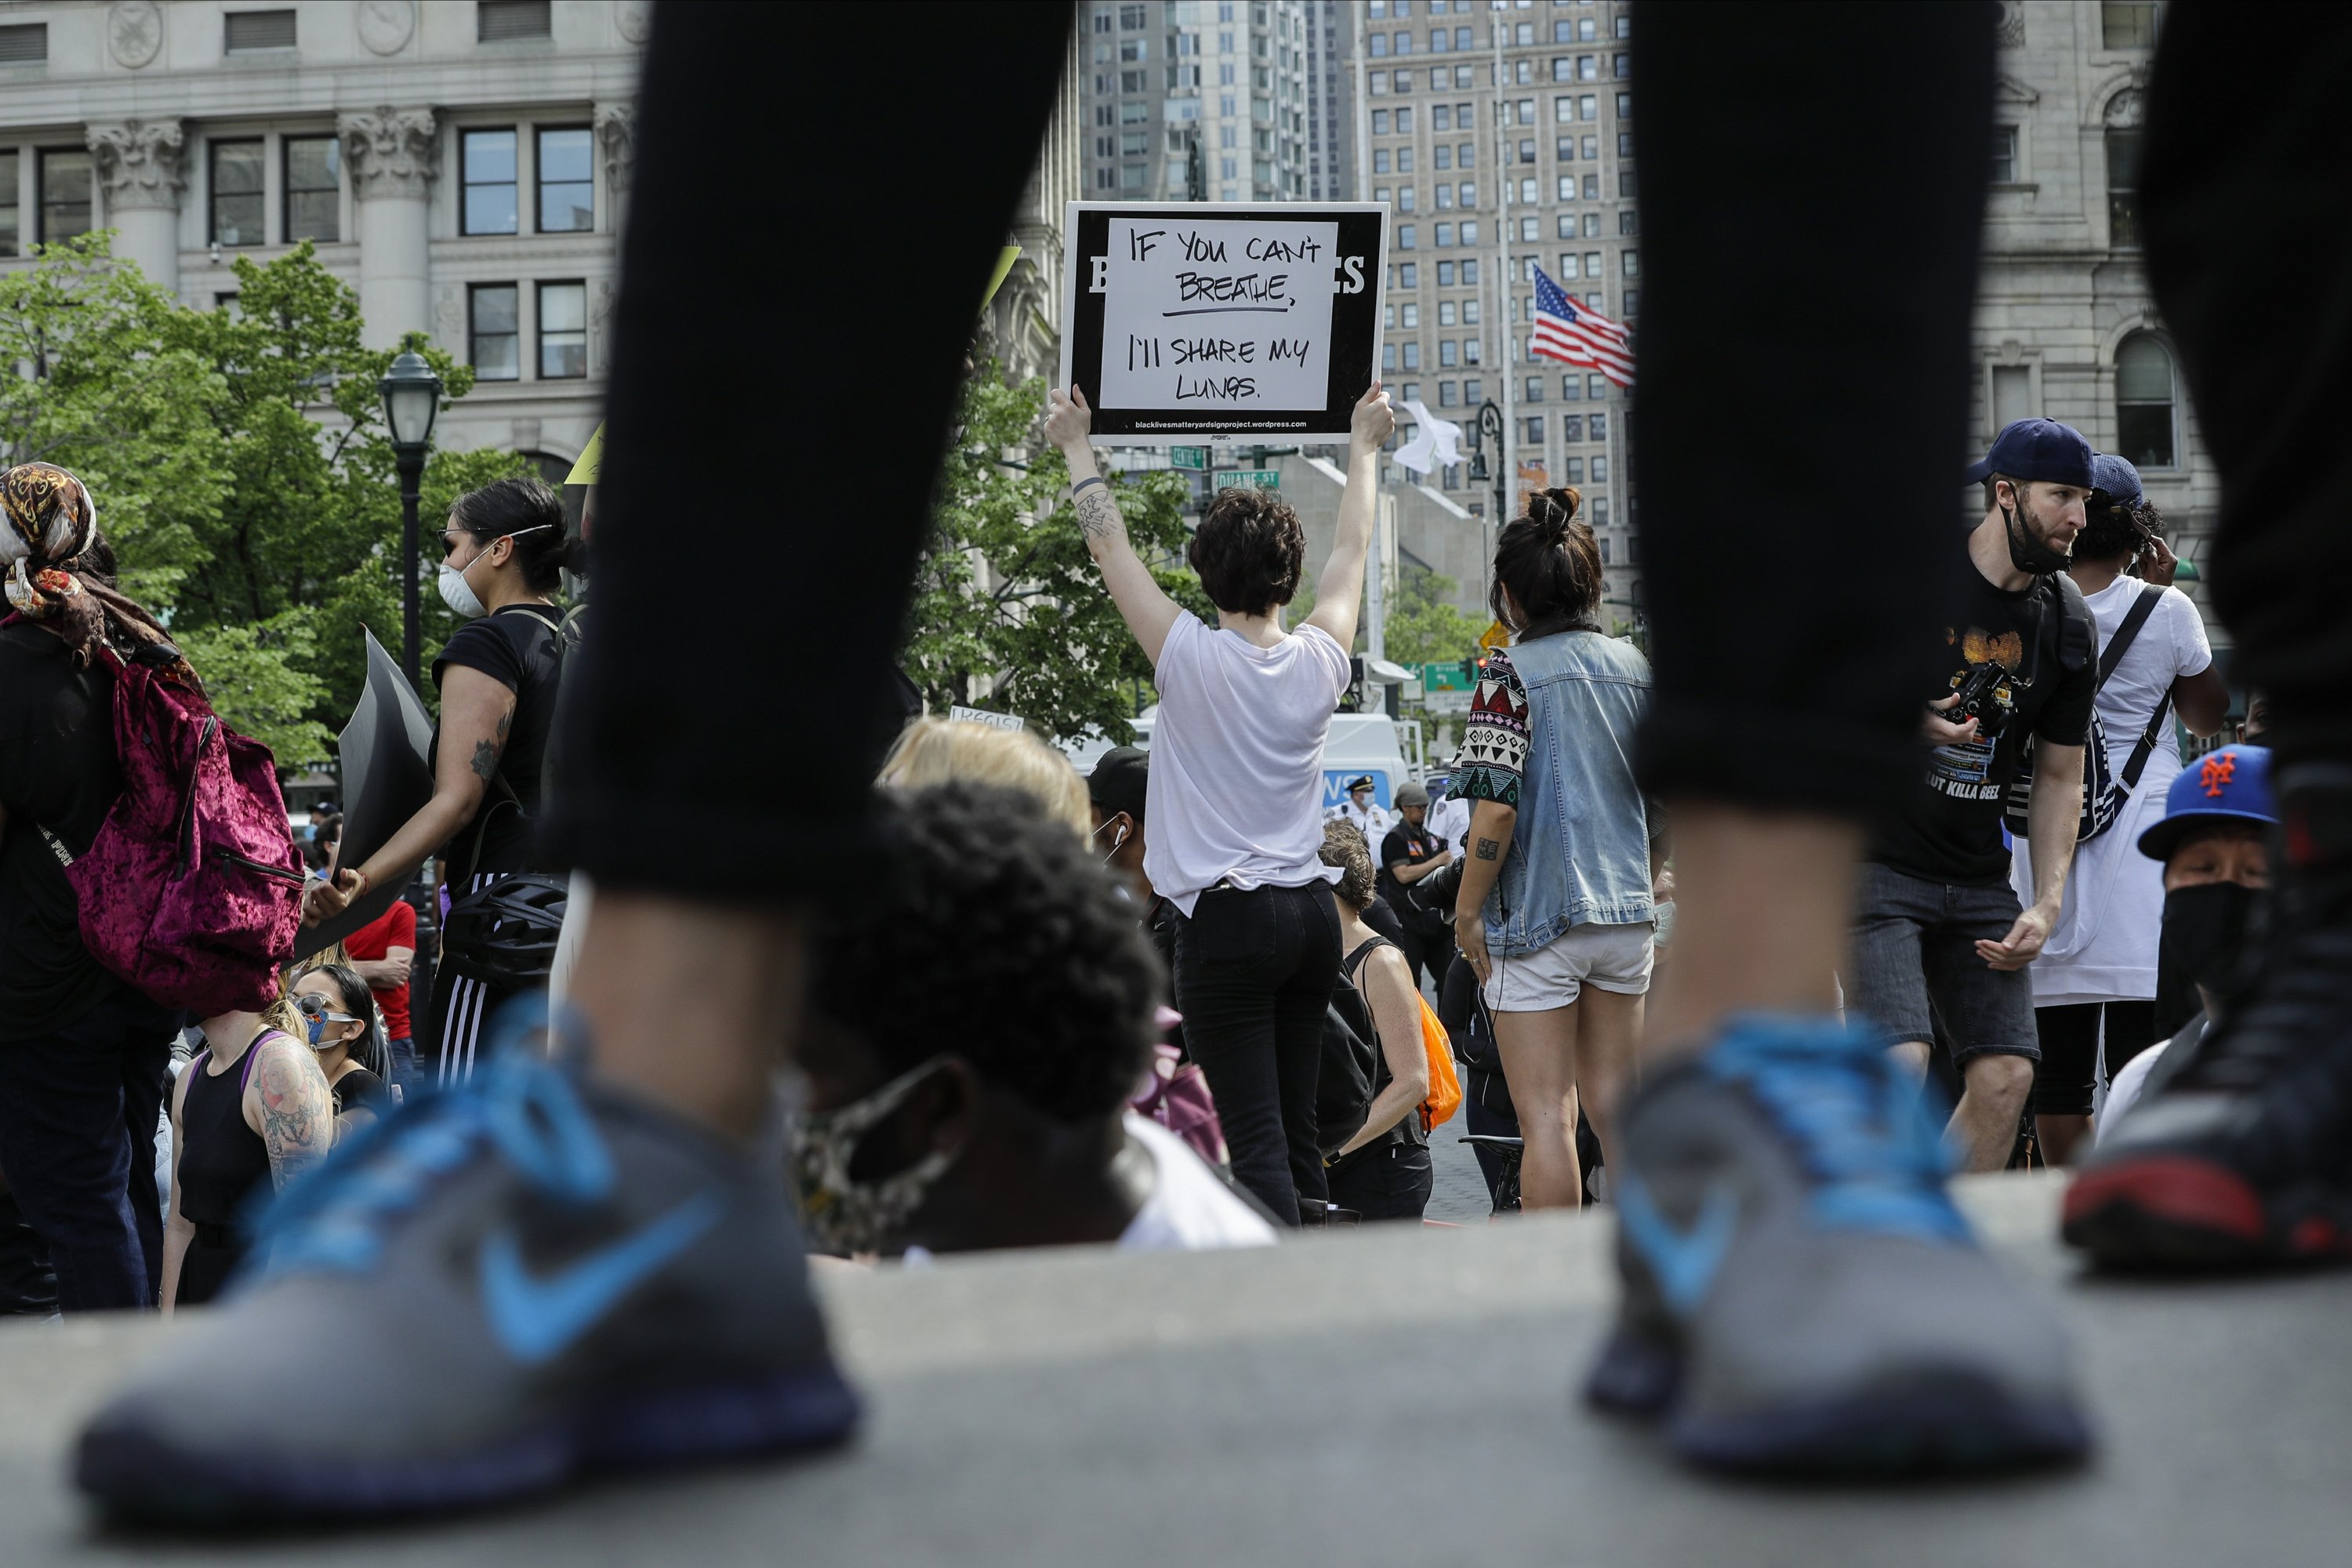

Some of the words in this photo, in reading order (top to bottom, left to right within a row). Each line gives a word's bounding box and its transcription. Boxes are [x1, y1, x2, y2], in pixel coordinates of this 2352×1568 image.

[1131, 227, 1167, 262] IF
[1177, 230, 1228, 263] YOU
[1175, 272, 1296, 307] BREATHE,
[1171, 337, 1255, 365] SHARE
[1269, 337, 1310, 368] MY
[1176, 373, 1260, 402] LUNGS.
[1135, 421, 1307, 430] blacklivesmatteryardsignproject.wordpress.com
[1173, 447, 1195, 467] CENTRE
[1262, 473, 1276, 483] ST
[1946, 782, 1977, 800] KILLA
[1980, 784, 2001, 800] BEEZ
[51, 839, 74, 866] PINK
